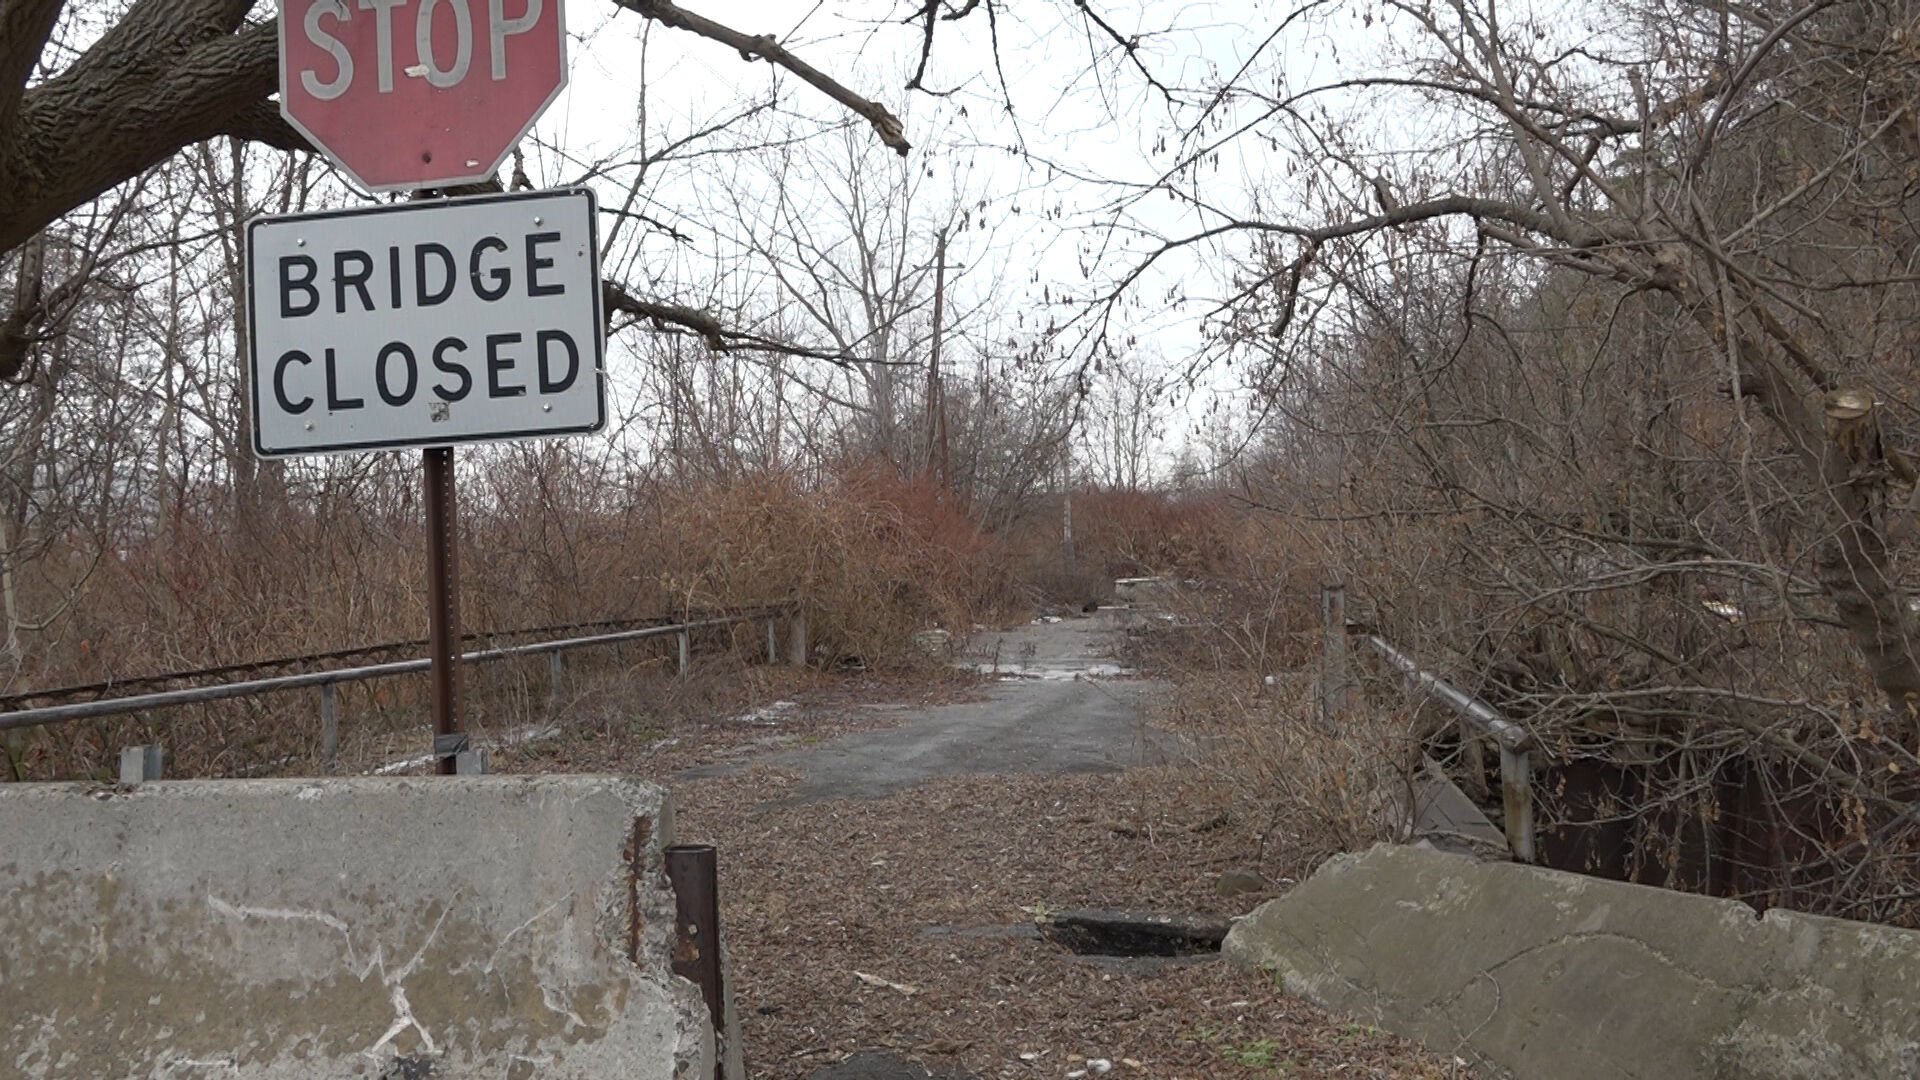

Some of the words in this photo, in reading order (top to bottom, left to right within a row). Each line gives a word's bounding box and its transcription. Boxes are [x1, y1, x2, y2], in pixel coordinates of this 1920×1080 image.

[301, 0, 543, 100] STOP
[279, 232, 565, 318] BRIDGE
[273, 329, 579, 415] CLOSED
